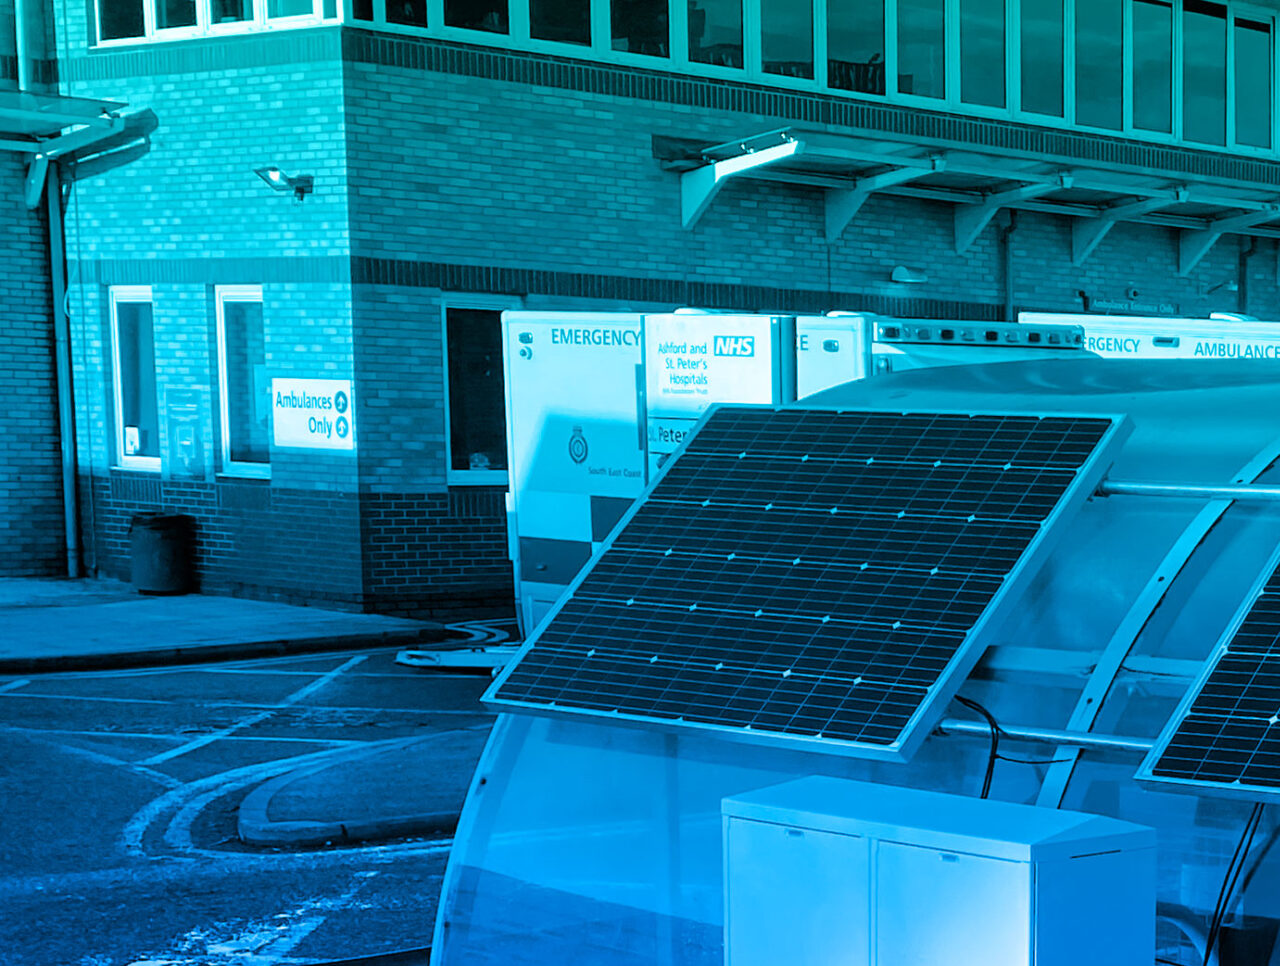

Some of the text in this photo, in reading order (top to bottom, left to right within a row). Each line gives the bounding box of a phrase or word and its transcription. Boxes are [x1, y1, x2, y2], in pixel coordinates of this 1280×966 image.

[551, 328, 641, 346] EMERGENCY
[658, 342, 708, 354] Ashford and
[715, 337, 753, 356] NHS
[677, 357, 707, 370] Peter's
[669, 373, 708, 386] Hospitals
[276, 390, 332, 410] Ambulances
[308, 416, 333, 439] Only
